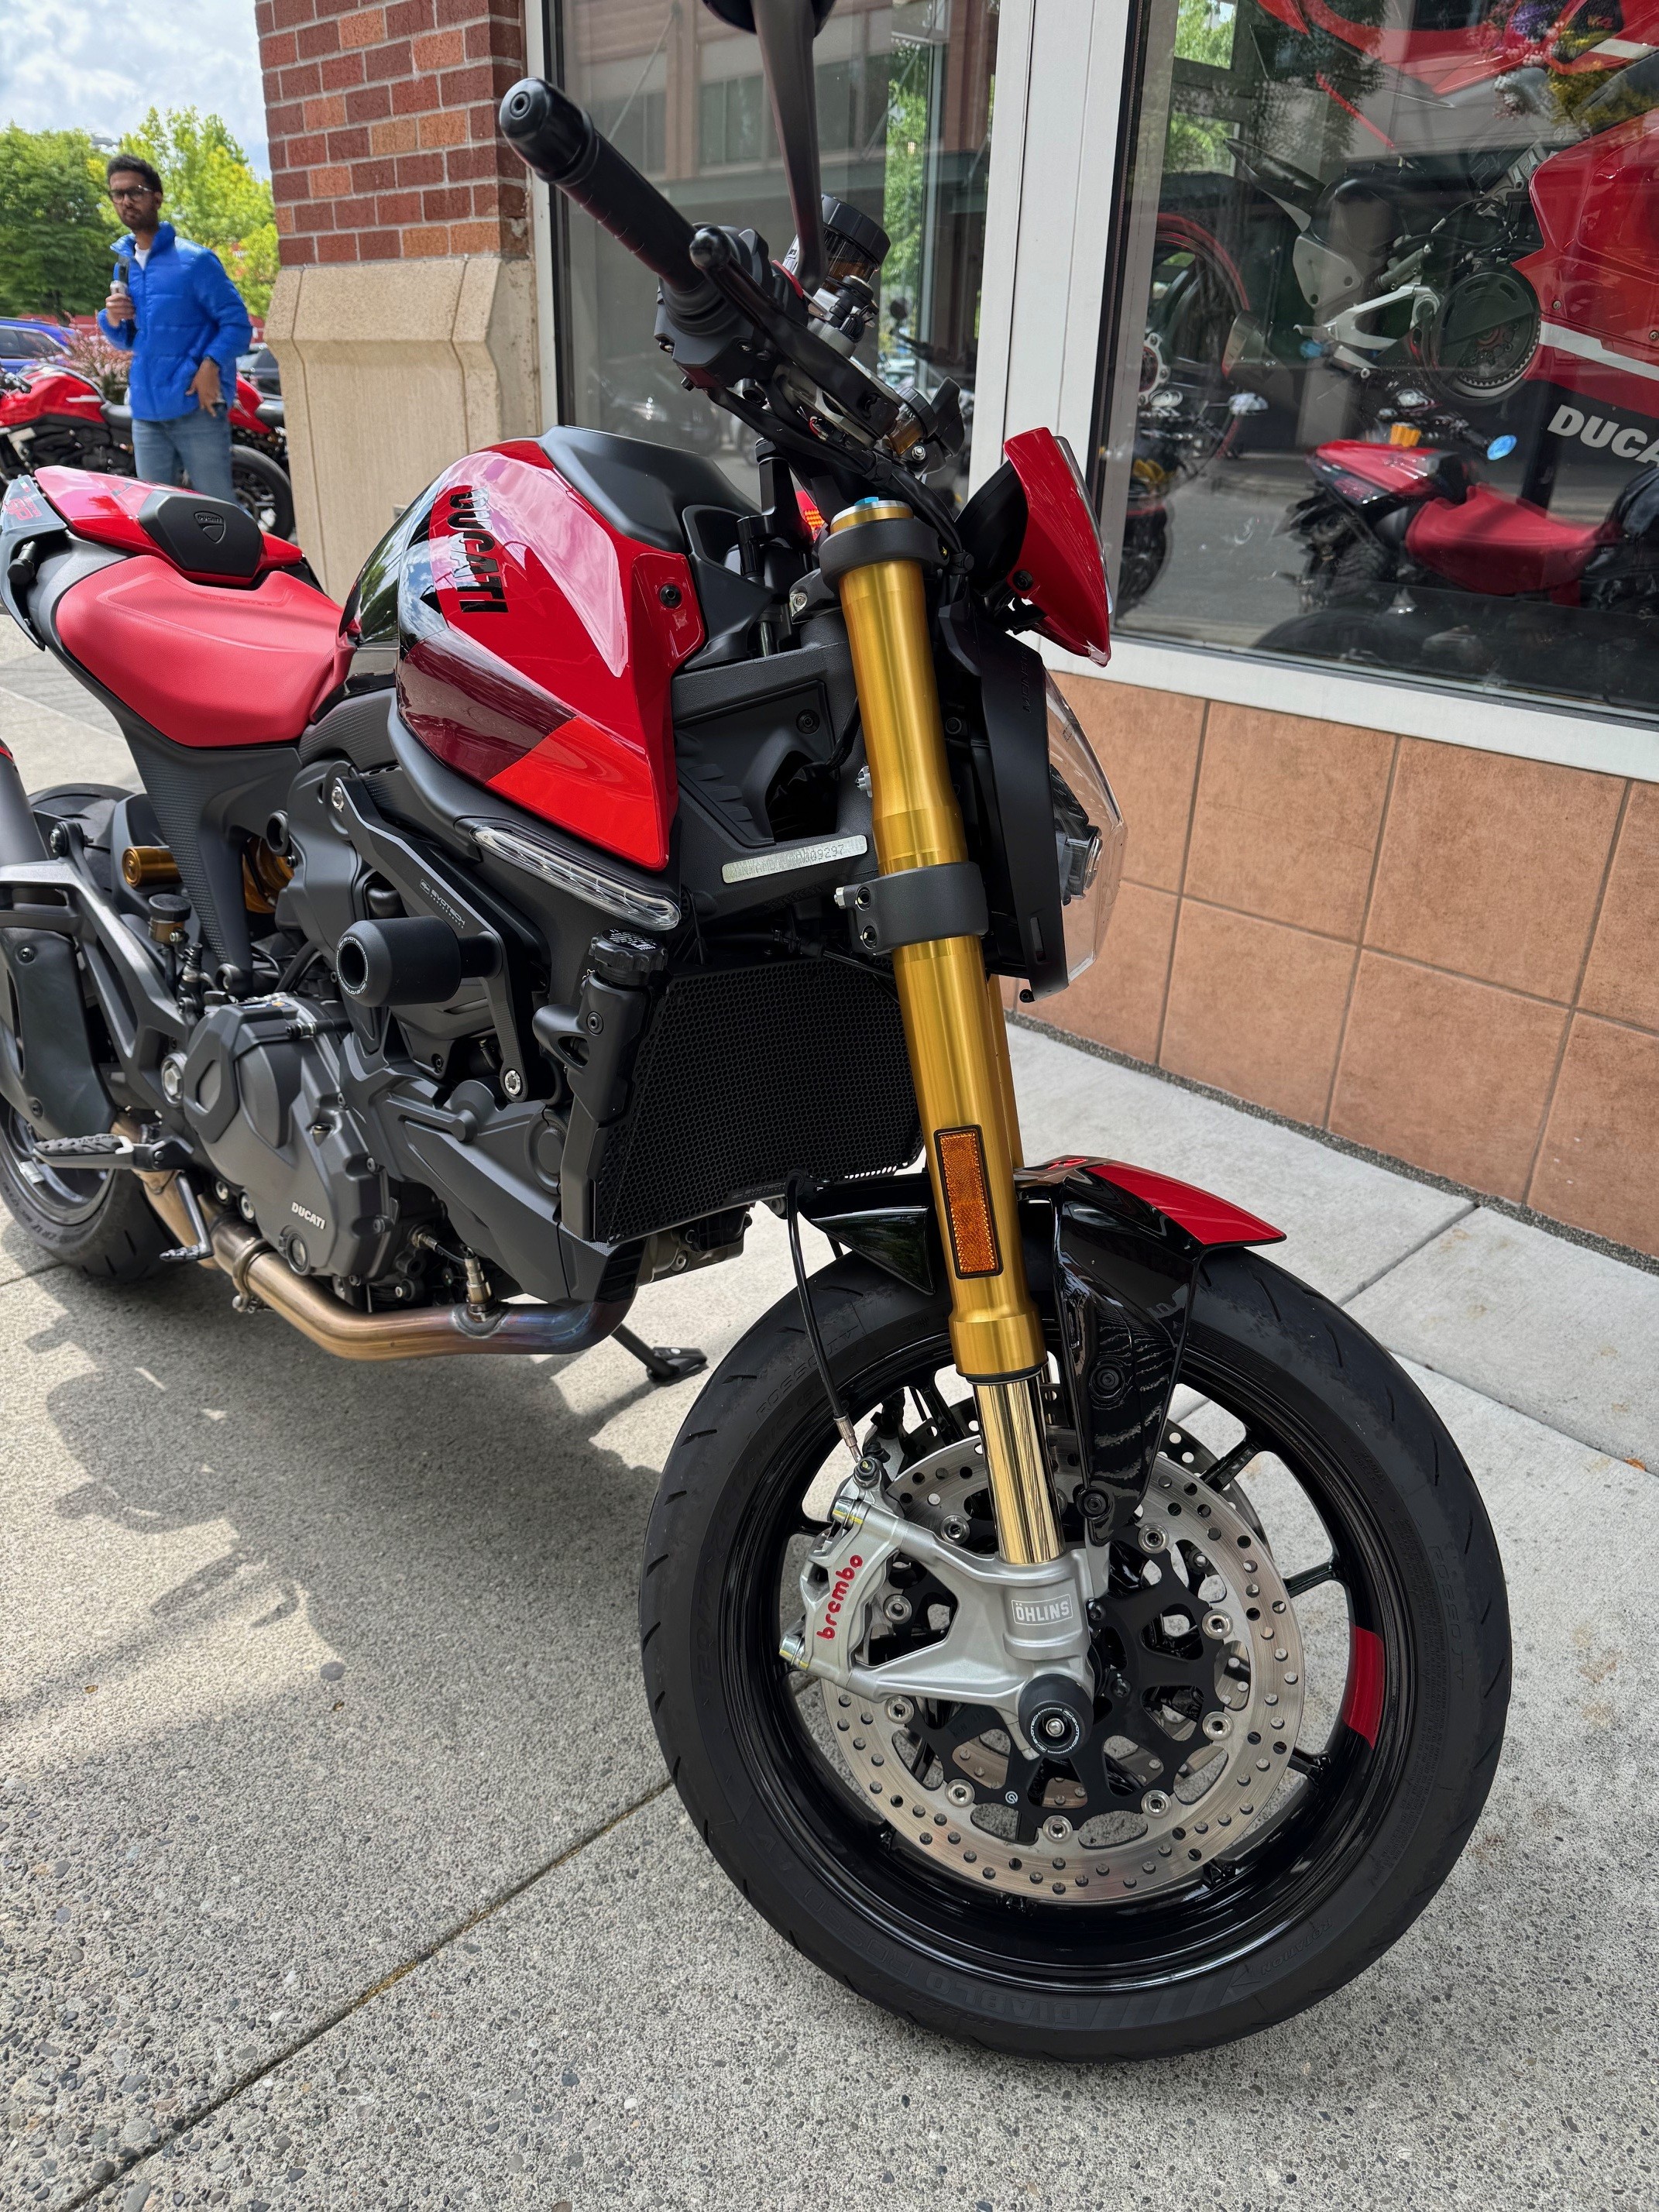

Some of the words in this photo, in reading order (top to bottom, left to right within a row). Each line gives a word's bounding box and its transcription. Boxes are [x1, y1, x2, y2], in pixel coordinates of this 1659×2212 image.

[198, 514, 222, 523] DUCATI
[448, 486, 509, 613] DUCATI
[431, 889, 466, 926] EVOTECH
[745, 1182, 786, 1194] EVOTECH
[291, 1201, 325, 1230] DUCATI
[816, 1554, 863, 1640] brembo
[1015, 1601, 1070, 1621] ÖHLINS
[803, 1885, 913, 1977] ROSSO
[1261, 1917, 1334, 1976] ROTATION
[926, 1970, 1080, 2027] DIABLO
